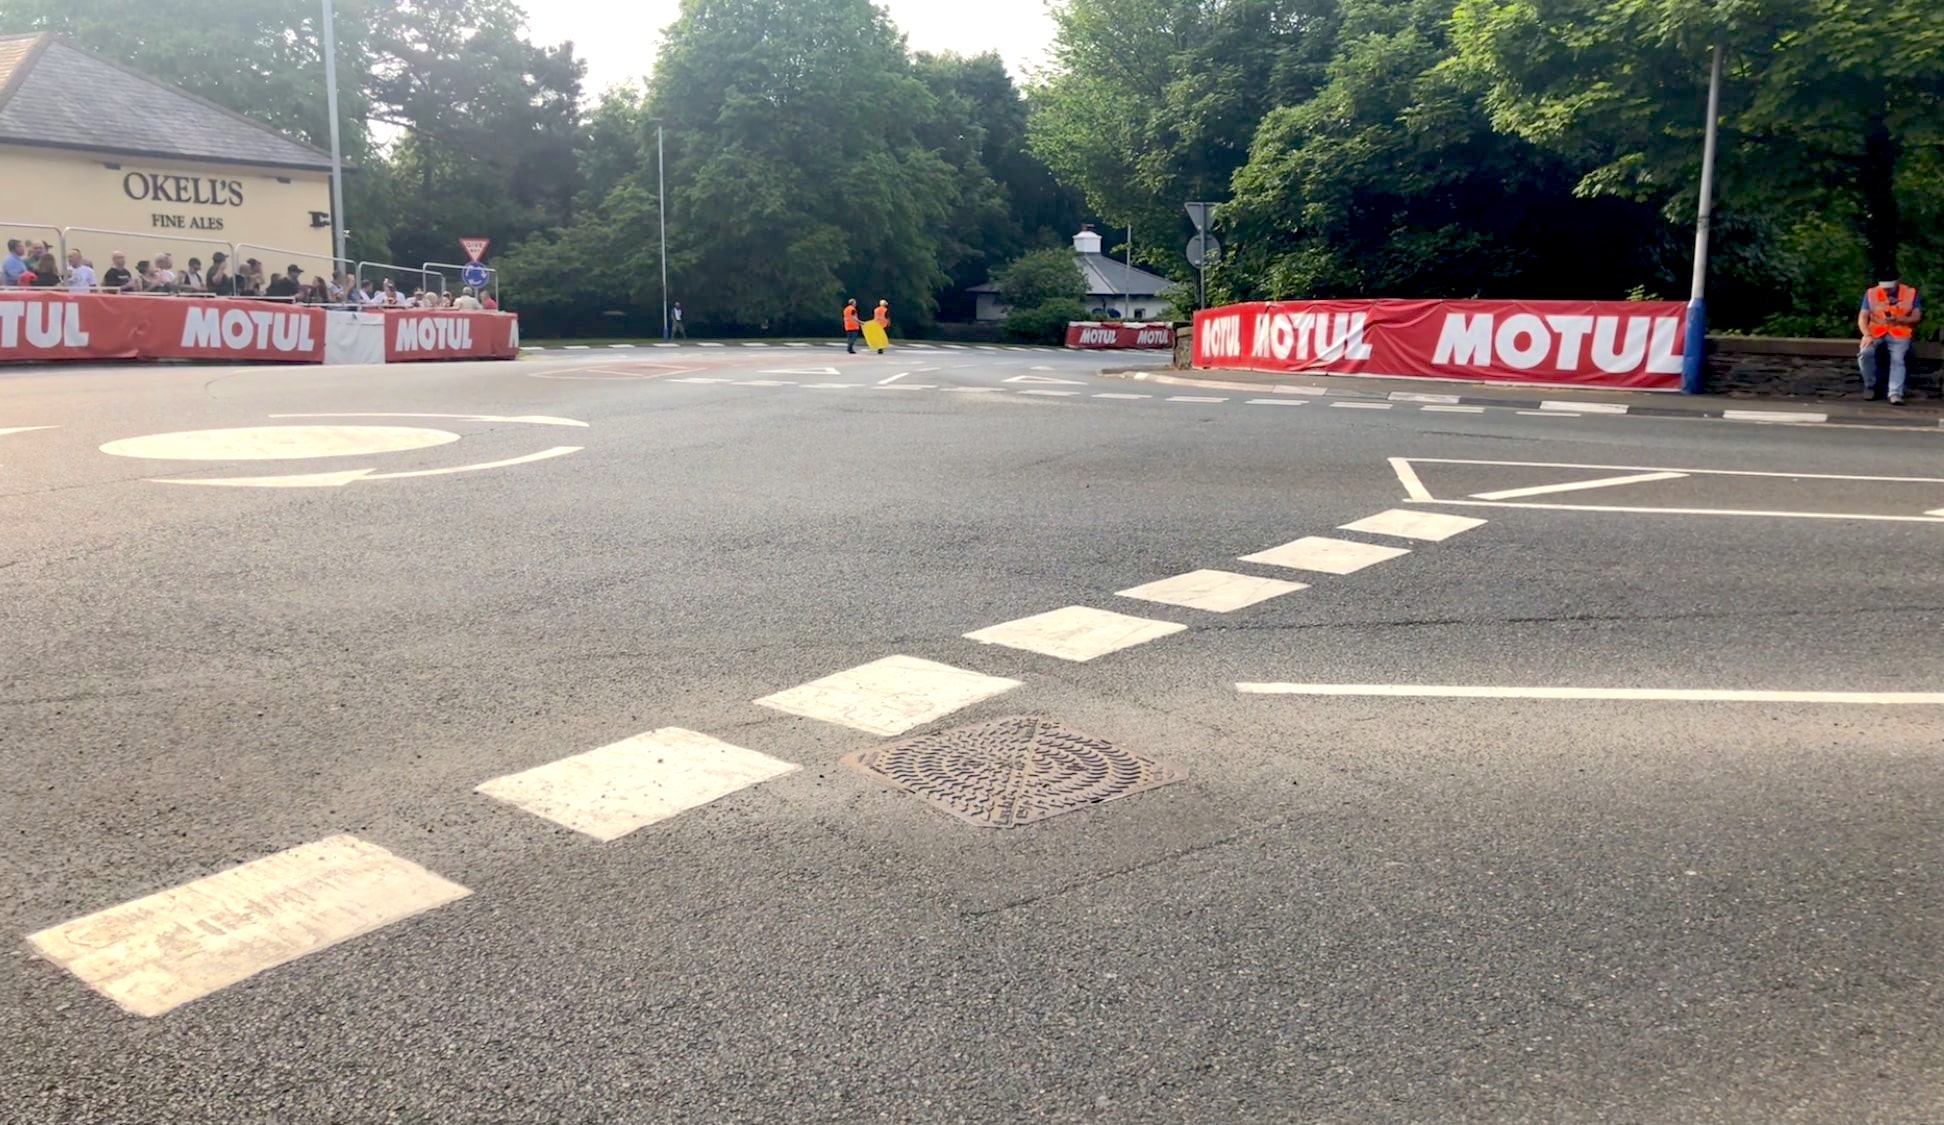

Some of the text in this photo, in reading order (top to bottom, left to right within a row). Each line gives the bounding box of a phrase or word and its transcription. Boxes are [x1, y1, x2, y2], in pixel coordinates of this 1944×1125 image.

[122, 171, 244, 207] OKELL'S
[152, 213, 224, 230] FINE ALES
[181, 306, 315, 351] MOTUL
[395, 317, 473, 352] MOTUL
[1080, 328, 1117, 344] MOTUL
[1202, 315, 1241, 358] MOTUL
[1252, 312, 1373, 361] MOTUL
[1431, 313, 1684, 373] MOTUL
